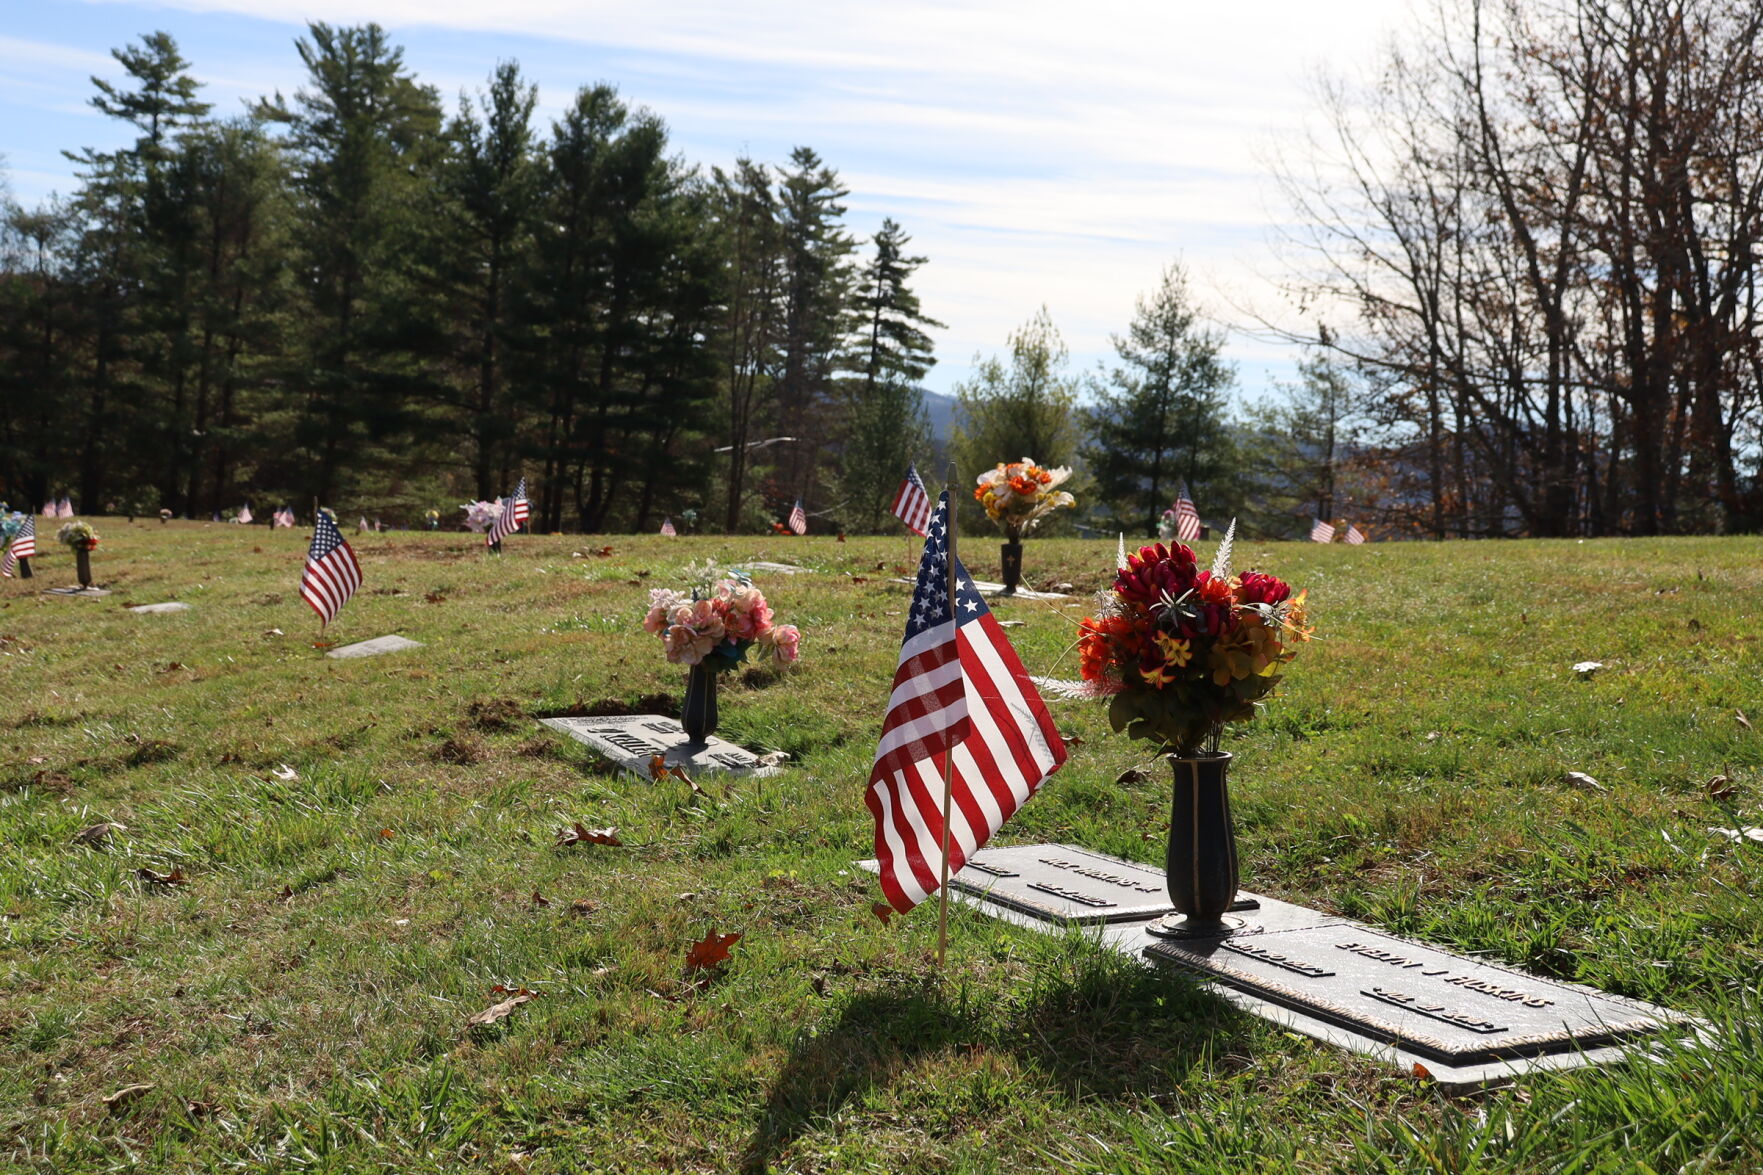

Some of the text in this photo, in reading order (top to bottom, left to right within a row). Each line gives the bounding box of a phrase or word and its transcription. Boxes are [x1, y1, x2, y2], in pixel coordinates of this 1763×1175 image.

[1334, 942, 1555, 1008] EVELYN J HUSKINS
